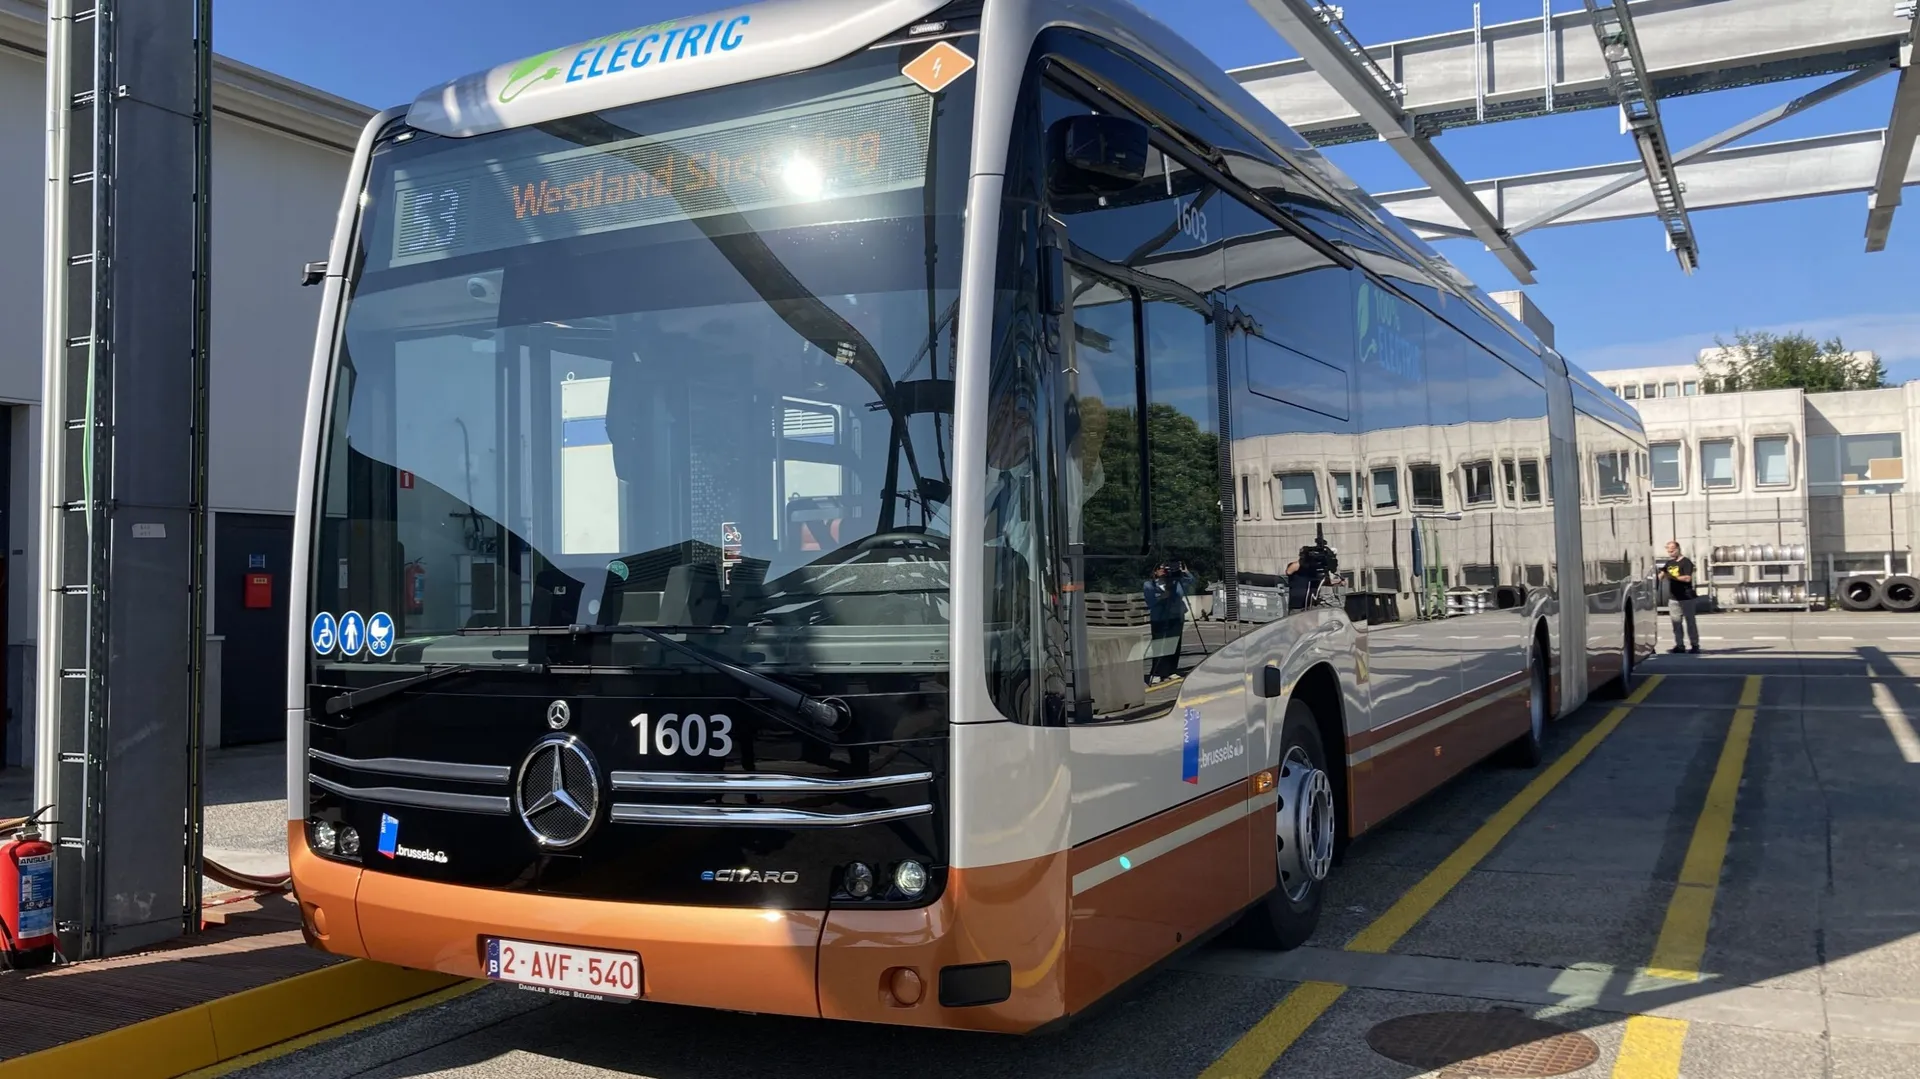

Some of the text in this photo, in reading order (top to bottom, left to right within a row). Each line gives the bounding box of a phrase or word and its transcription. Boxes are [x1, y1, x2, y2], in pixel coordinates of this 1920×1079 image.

[565, 15, 750, 83] ELECTRIC
[408, 130, 881, 251] 53 Westland Shoing
[1173, 198, 1208, 245] 1603
[630, 713, 733, 757] 1603
[700, 868, 800, 884] eCITARO
[489, 946, 634, 989] B 2-AVF-540
